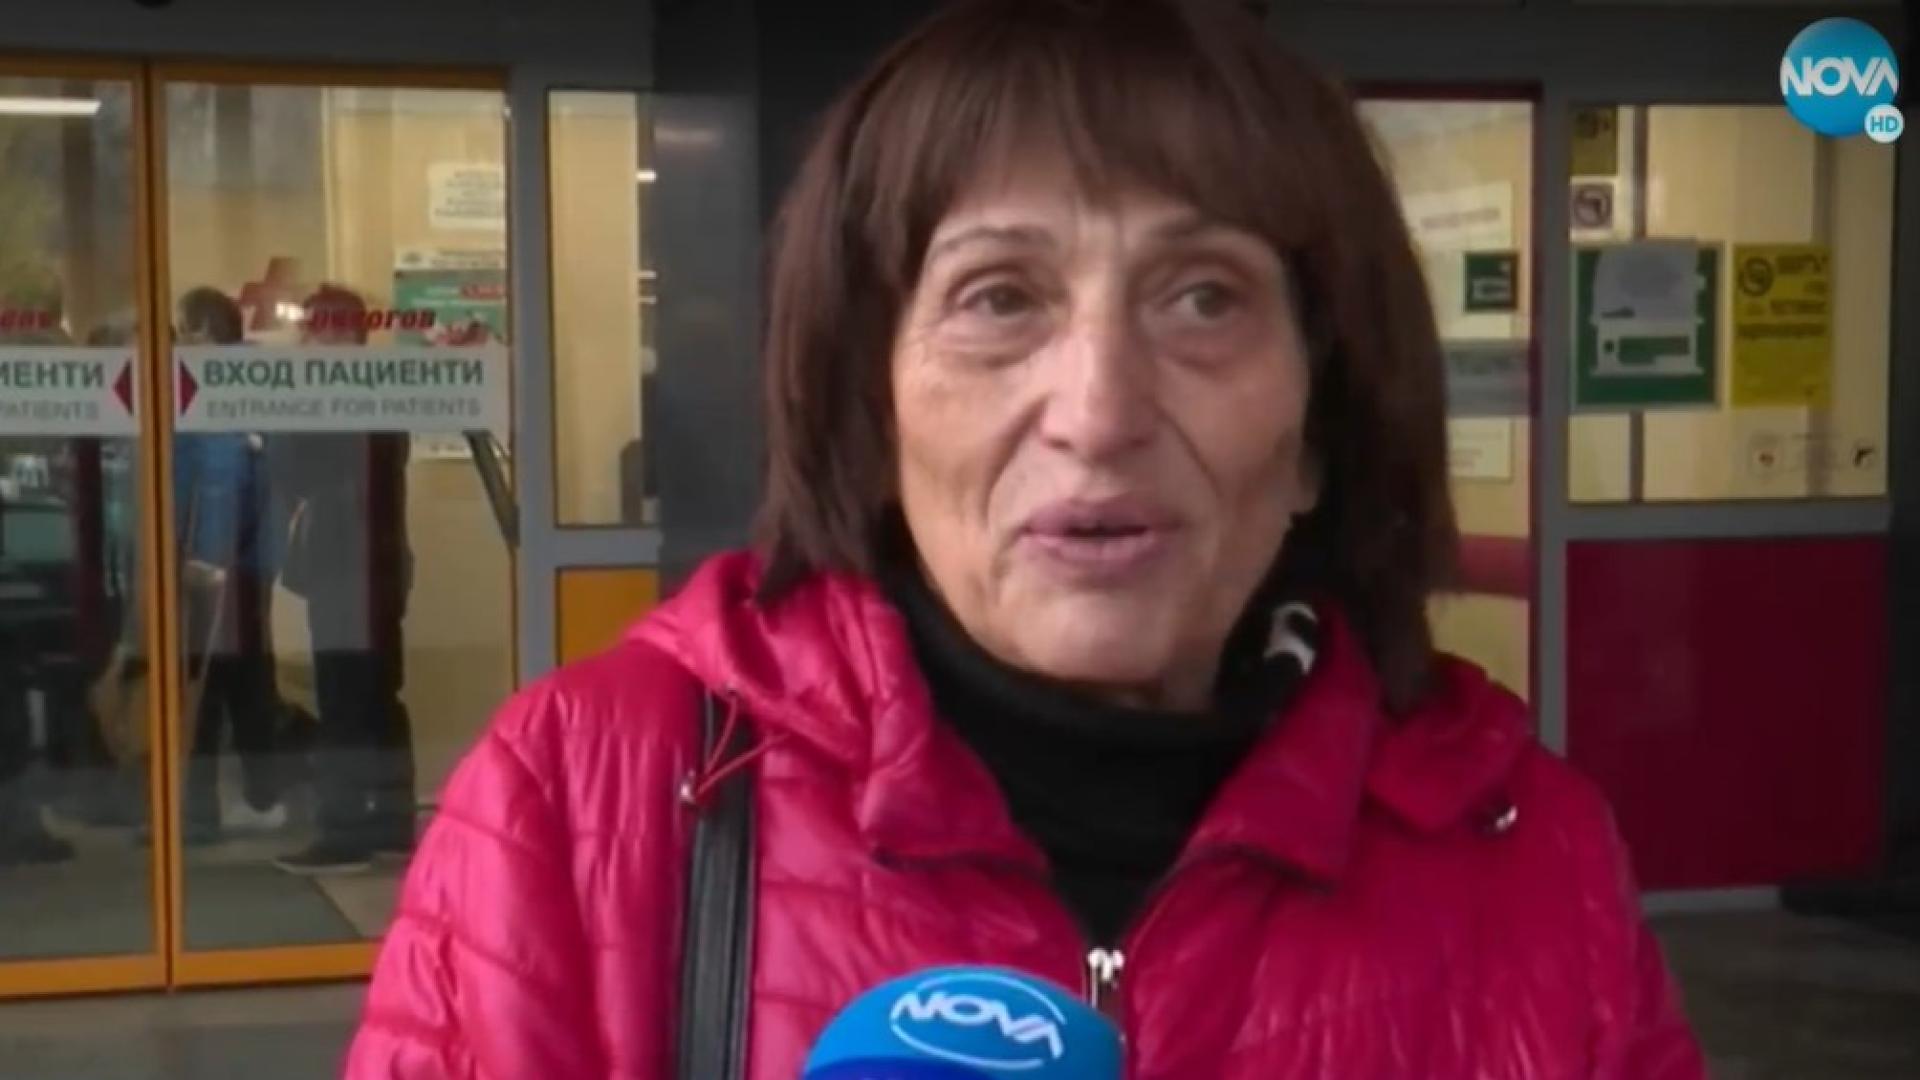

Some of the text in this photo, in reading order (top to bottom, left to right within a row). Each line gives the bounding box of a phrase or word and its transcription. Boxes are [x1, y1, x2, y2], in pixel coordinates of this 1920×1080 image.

[203, 359, 484, 389] ВХОД ПАЦИЕНТИ
[206, 398, 482, 418] ENTRANCE FOR PATIENTS
[888, 990, 1064, 1060] NOVA
